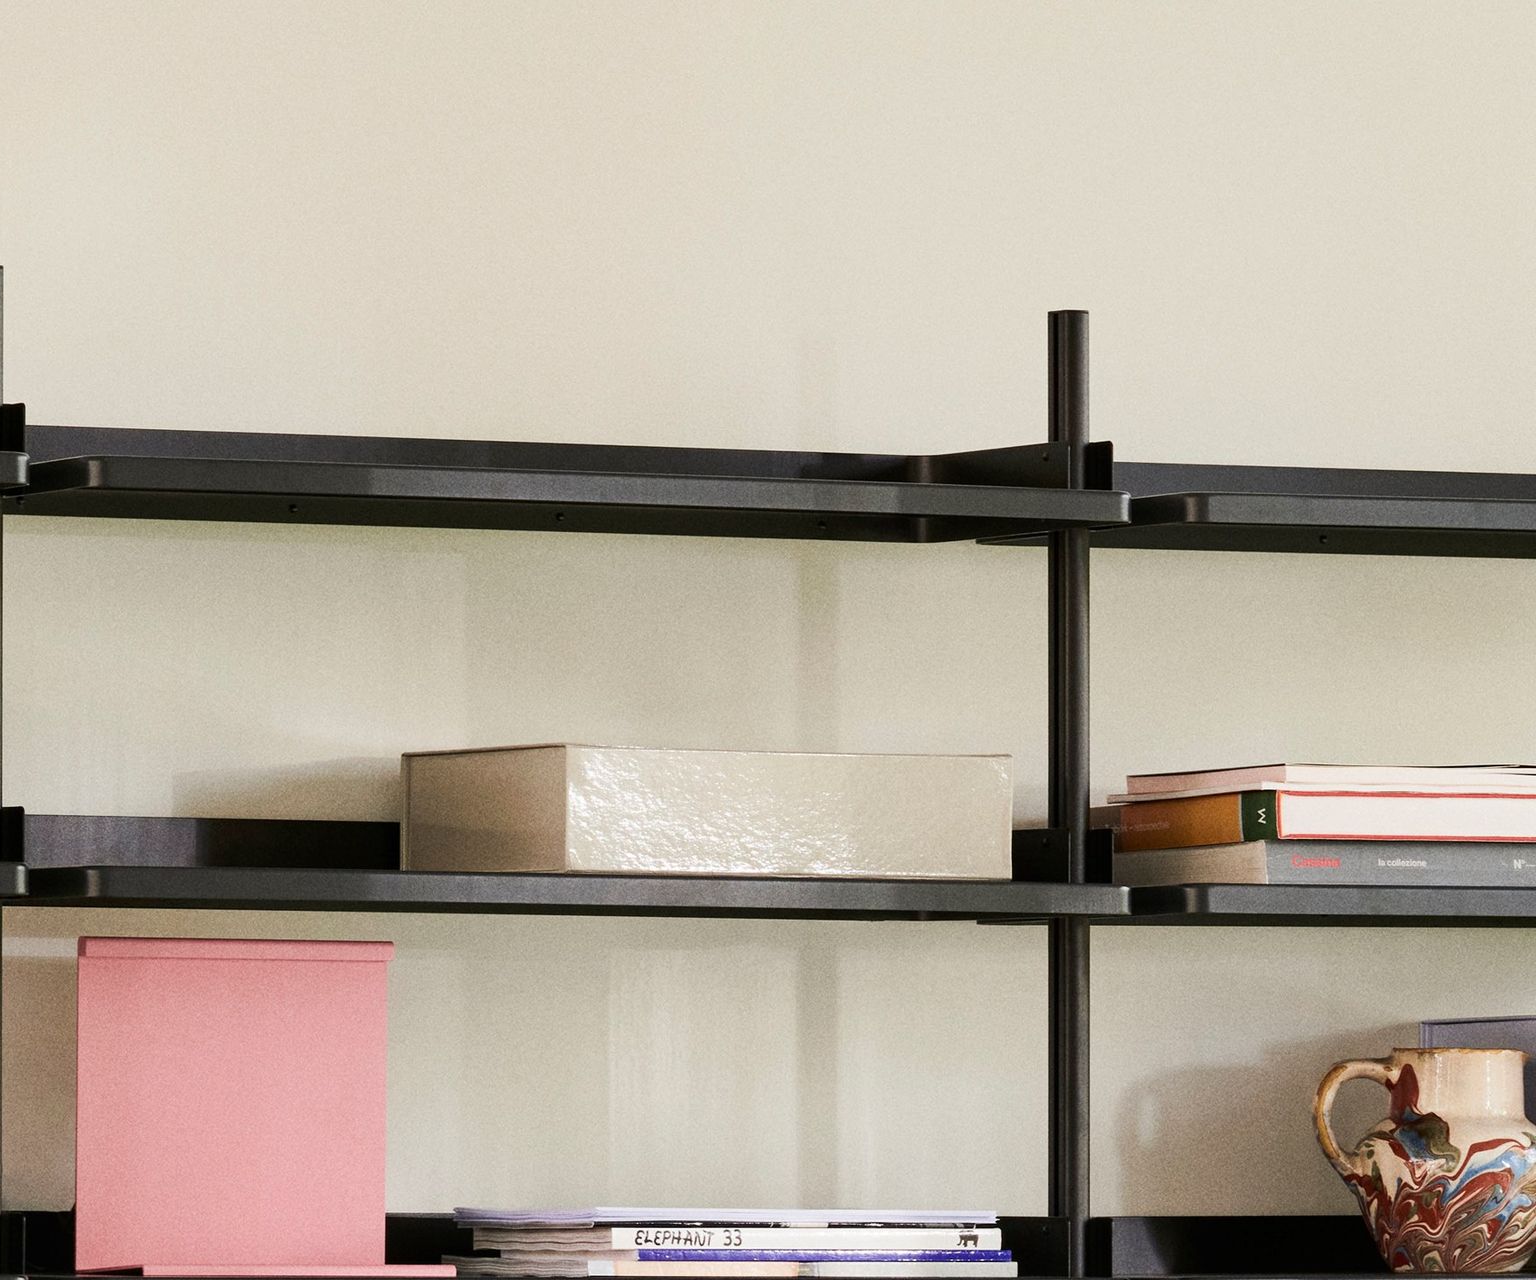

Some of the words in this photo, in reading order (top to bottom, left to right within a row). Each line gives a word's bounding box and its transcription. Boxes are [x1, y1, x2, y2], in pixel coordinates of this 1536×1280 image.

[1386, 859, 1427, 867] collezione
[635, 1229, 715, 1246] ELEPHANT
[723, 1230, 743, 1247] 33
